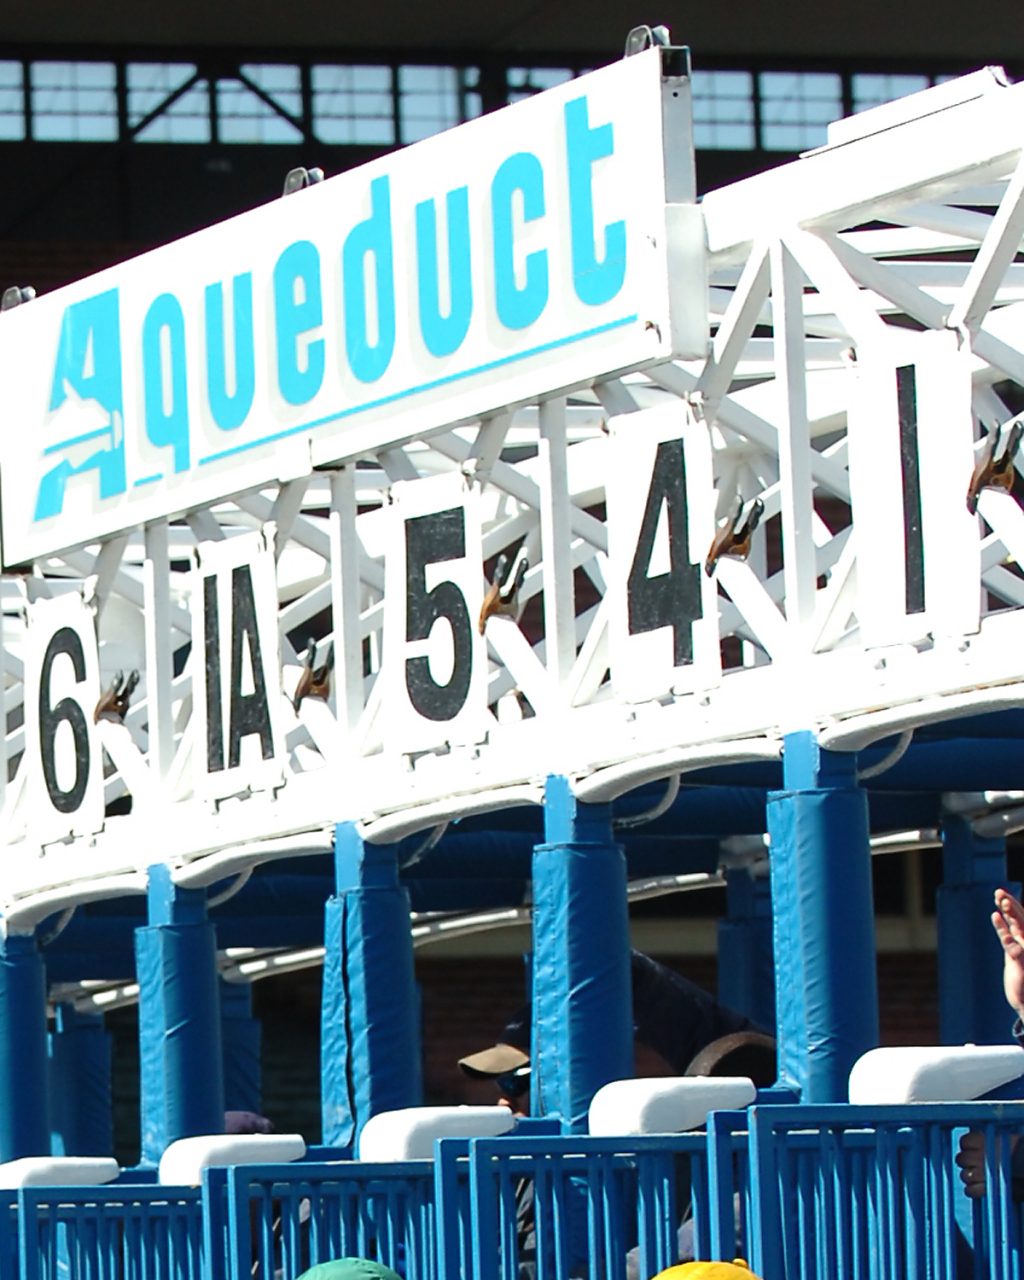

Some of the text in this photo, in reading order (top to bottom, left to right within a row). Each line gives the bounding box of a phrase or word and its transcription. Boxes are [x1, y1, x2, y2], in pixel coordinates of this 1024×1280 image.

[34, 96, 627, 520] Aqueduct
[404, 506, 472, 722] 5
[627, 438, 704, 667] 4
[39, 627, 89, 813] 6
